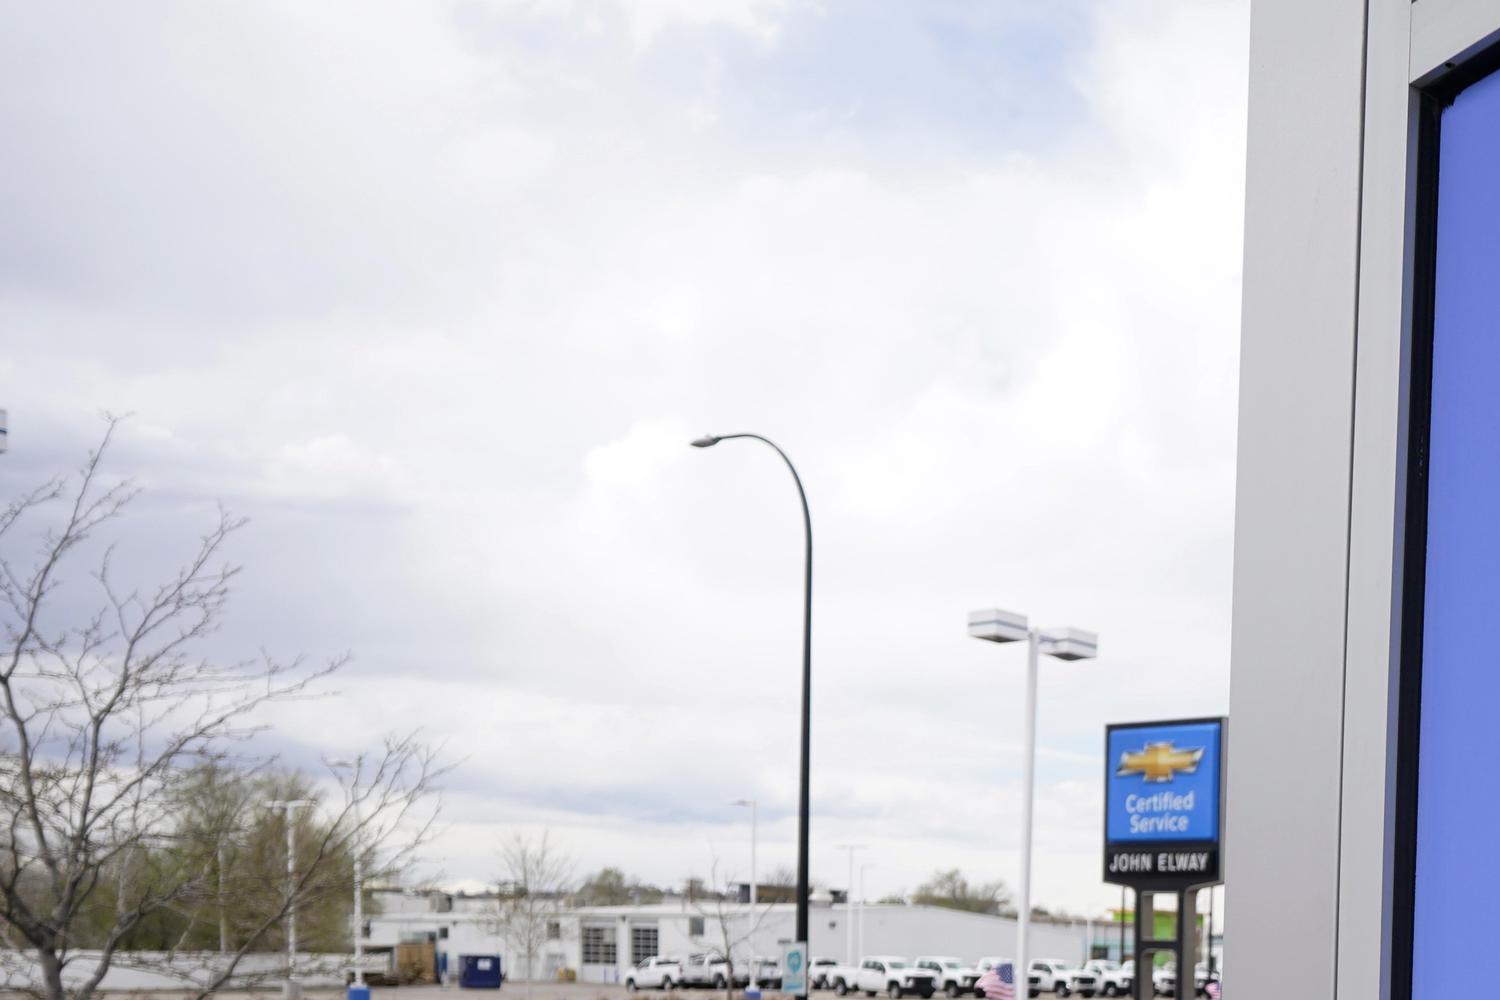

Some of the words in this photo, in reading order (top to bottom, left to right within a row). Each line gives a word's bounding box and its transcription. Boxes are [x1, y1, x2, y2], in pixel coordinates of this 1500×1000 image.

[1125, 790, 1195, 814] Certified
[1130, 813, 1189, 834] Service
[1109, 853, 1152, 872] JOHN
[1157, 852, 1209, 872] ELWAY
